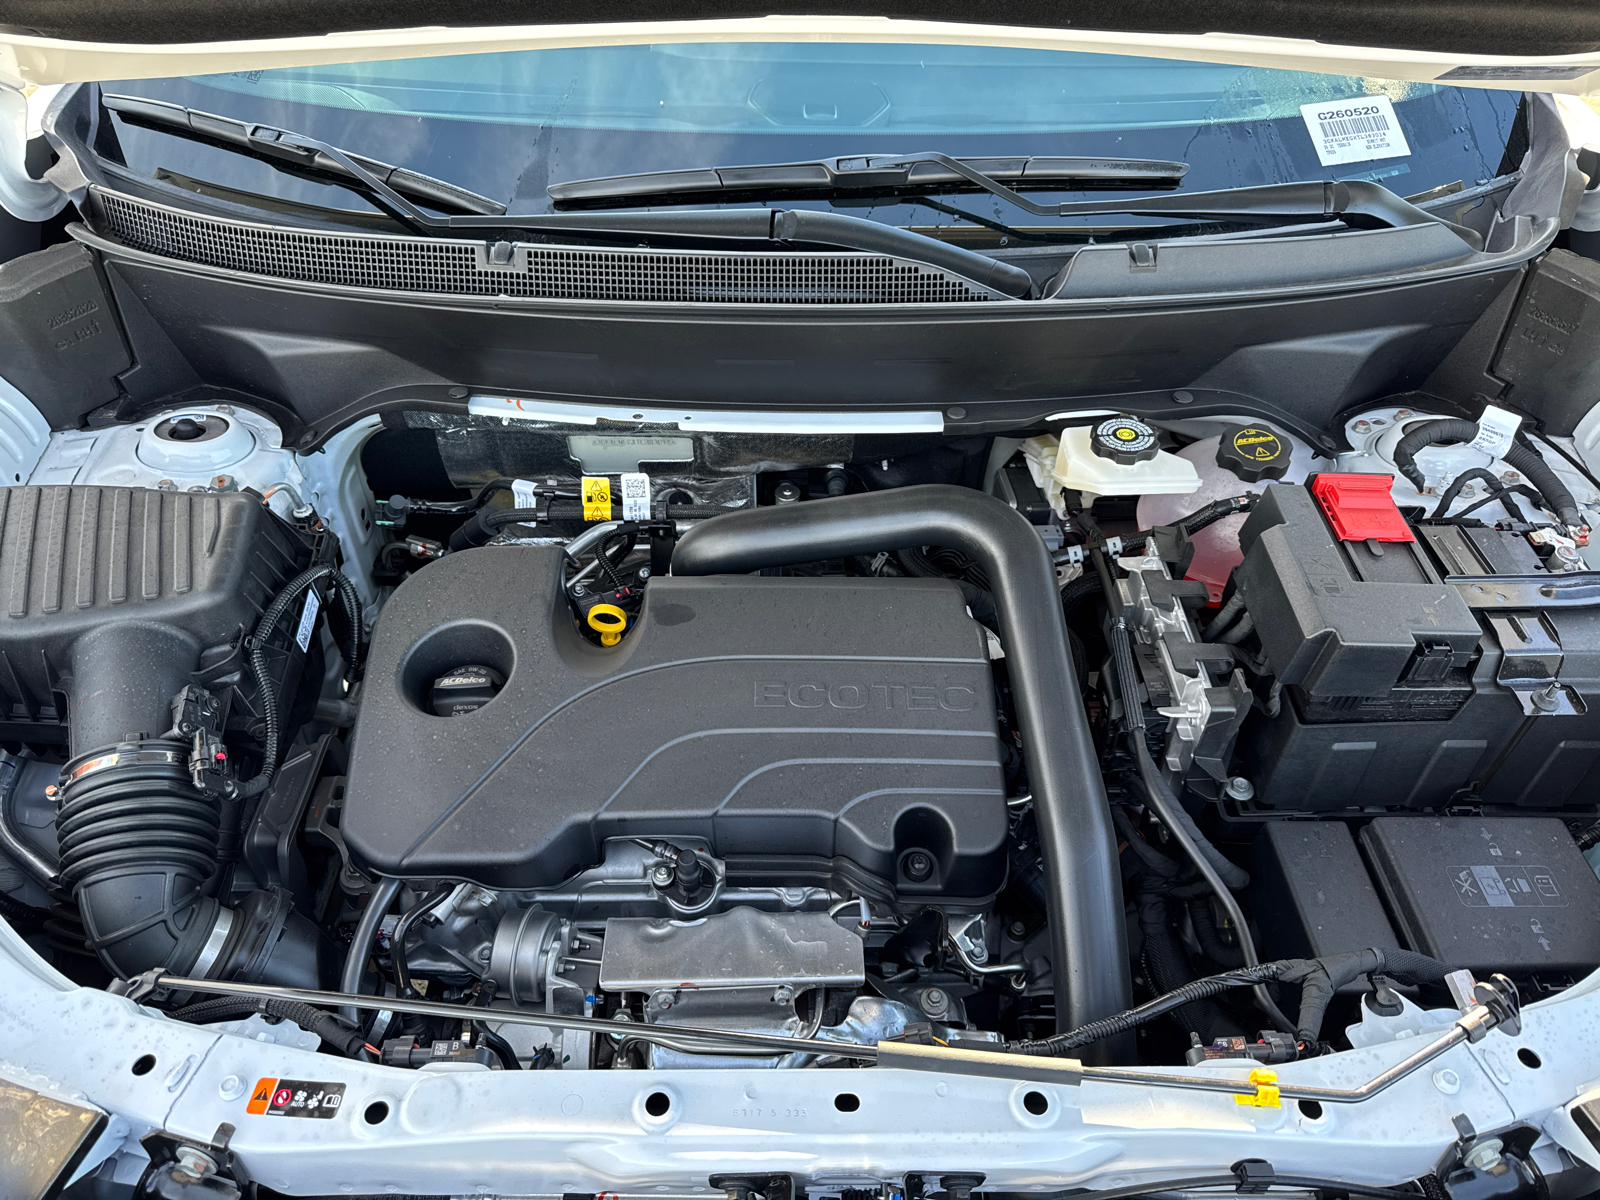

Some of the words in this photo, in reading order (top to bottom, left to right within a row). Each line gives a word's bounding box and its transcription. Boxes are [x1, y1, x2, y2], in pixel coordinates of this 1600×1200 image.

[1318, 106, 1379, 121] G260520
[1236, 436, 1274, 446] ACDelco
[440, 676, 486, 687] ACDelco
[753, 679, 977, 713] ECOTEC
[452, 1041, 459, 1050] B
